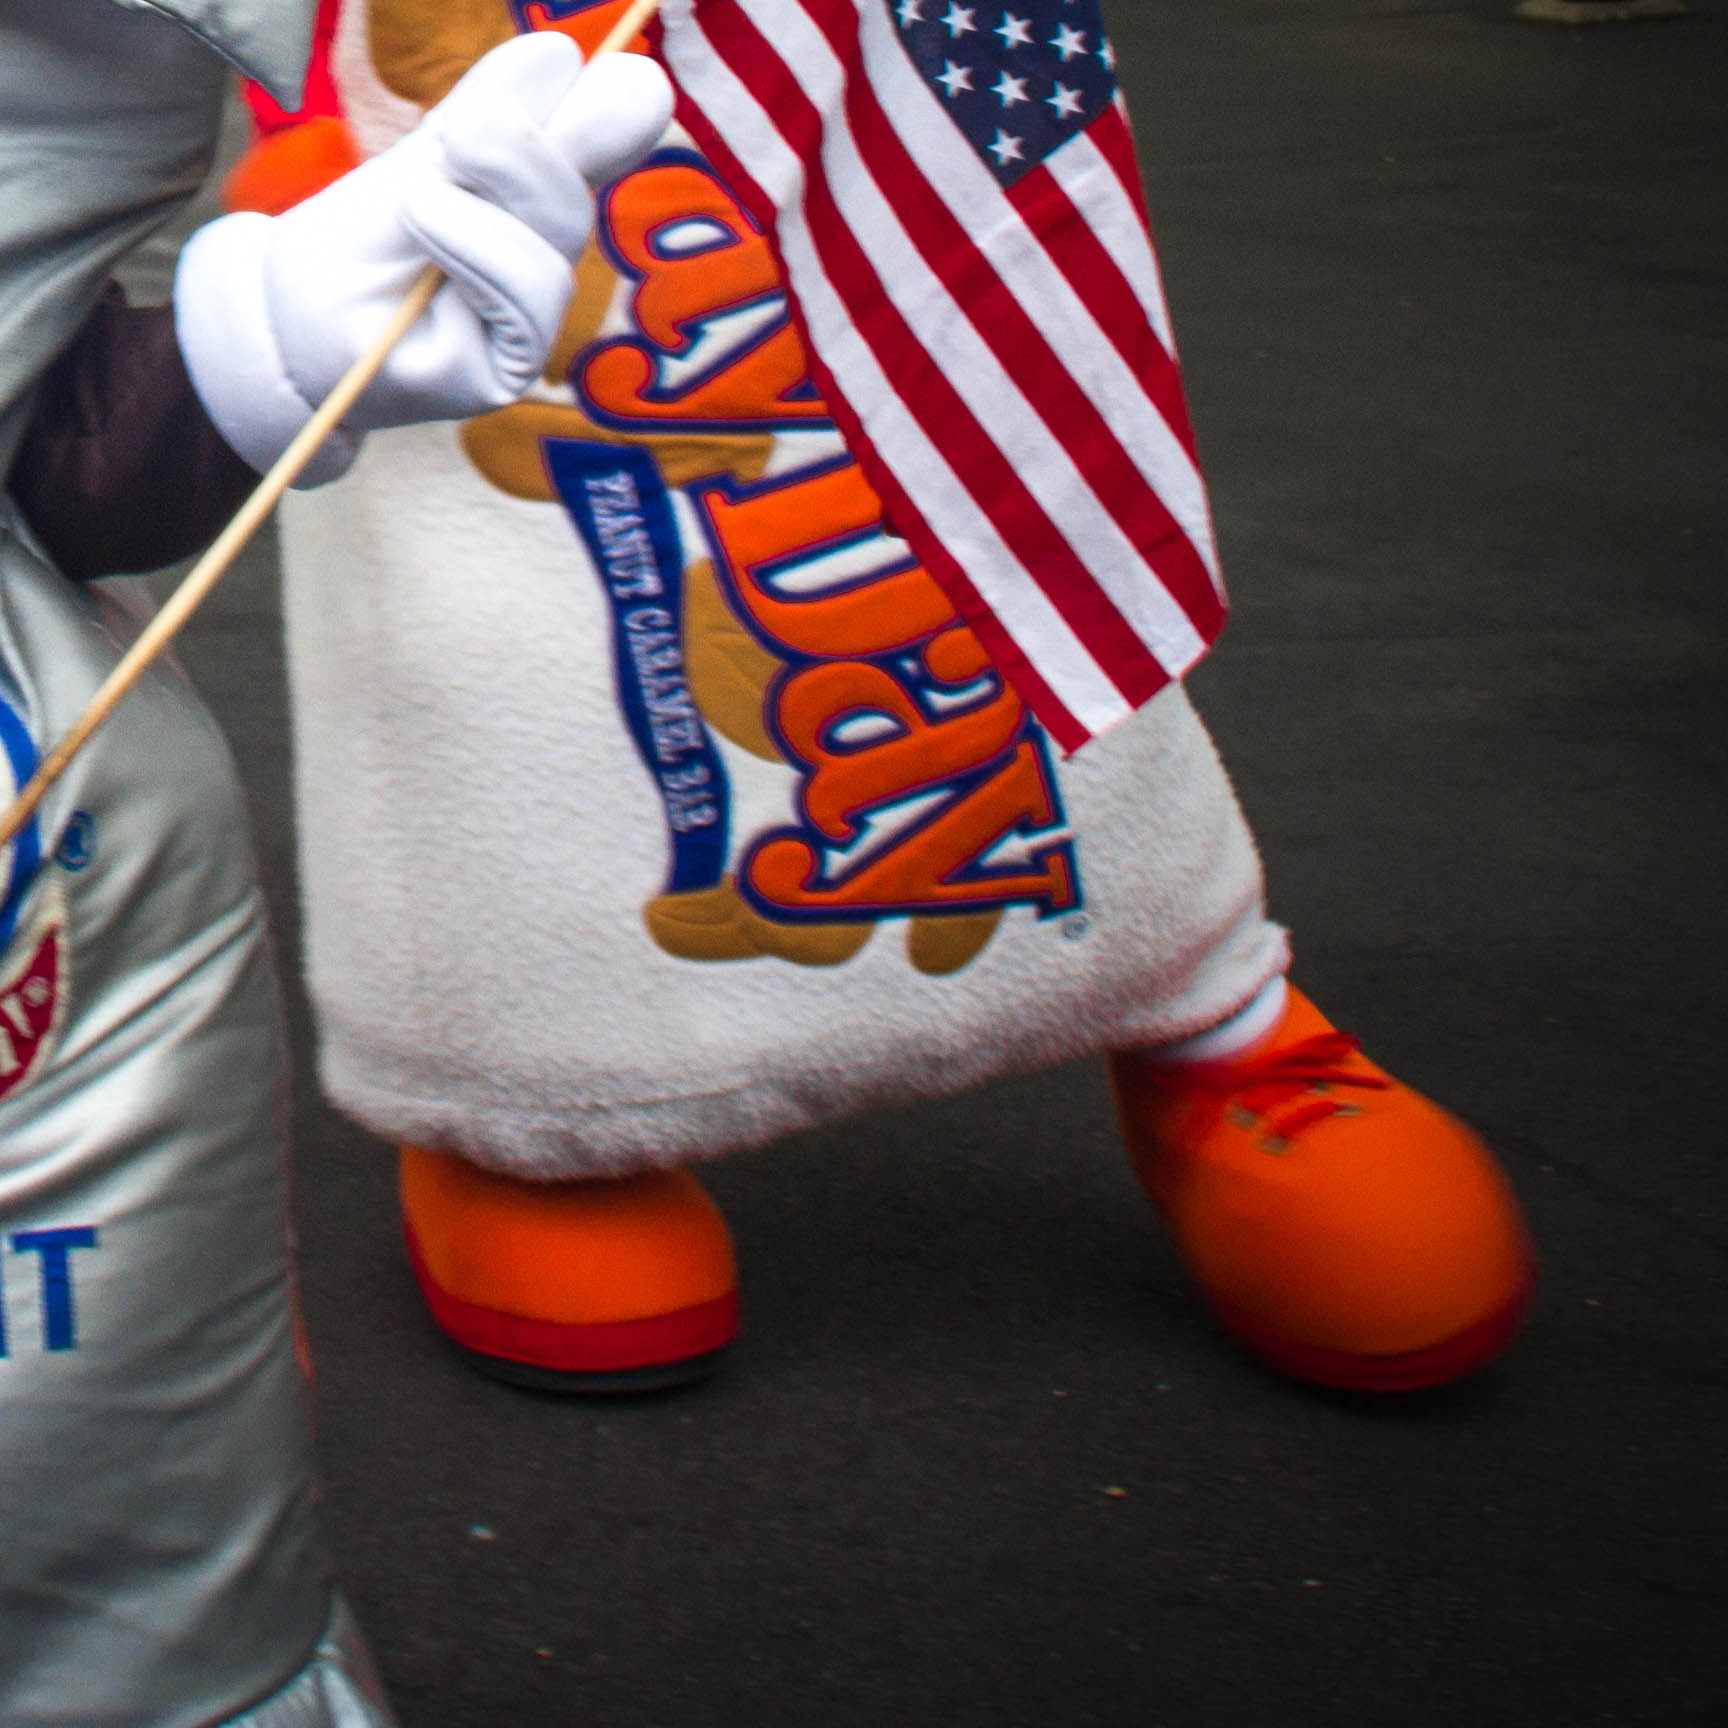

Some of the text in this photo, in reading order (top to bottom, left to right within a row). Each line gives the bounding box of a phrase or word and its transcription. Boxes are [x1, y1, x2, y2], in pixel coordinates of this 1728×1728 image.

[585, 469, 719, 834] PEANUT CARAMEL BAR
